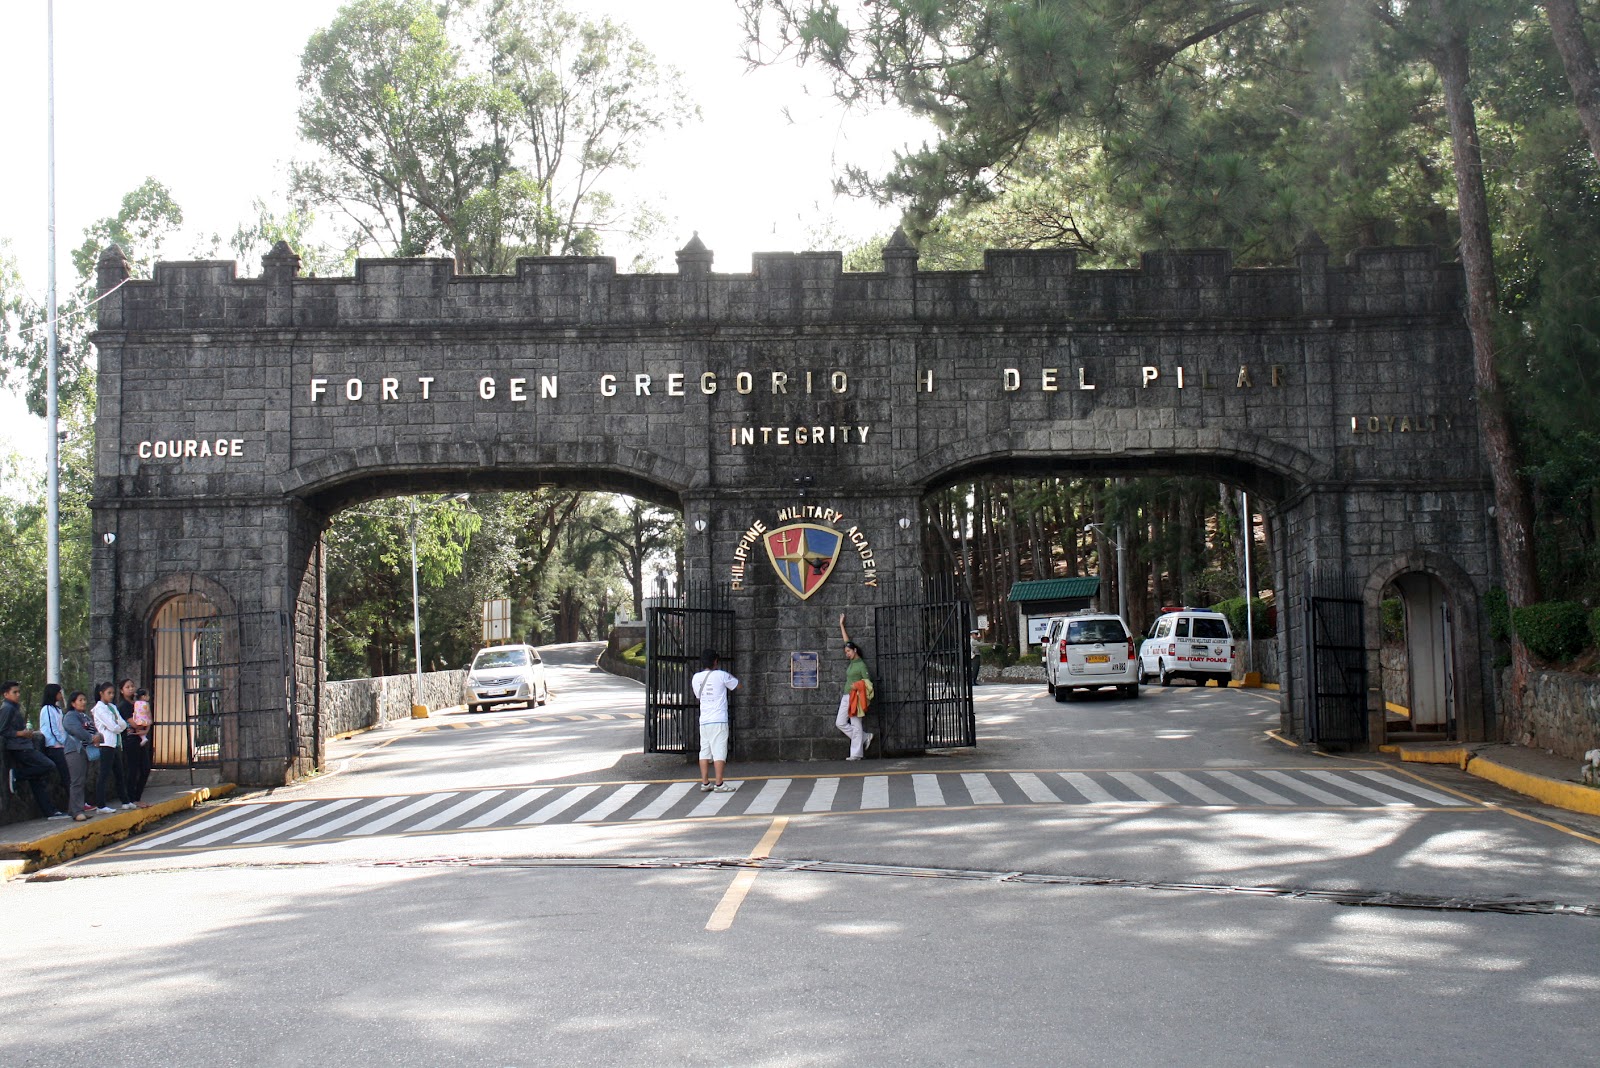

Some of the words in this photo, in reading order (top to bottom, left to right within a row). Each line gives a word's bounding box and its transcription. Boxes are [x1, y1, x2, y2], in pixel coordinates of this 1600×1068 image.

[311, 377, 434, 401] FORT
[479, 375, 559, 401] GEN
[600, 371, 849, 397] GREGORIO
[916, 369, 934, 392] H
[1003, 367, 1096, 391] DEL
[1142, 364, 1287, 389] PILAR
[138, 438, 245, 459] COURAGE
[731, 426, 870, 446] INTEGRITY
[730, 519, 767, 591] PHILIPPINE
[777, 505, 843, 524] MILITARY
[846, 525, 878, 587] ACADEMY
